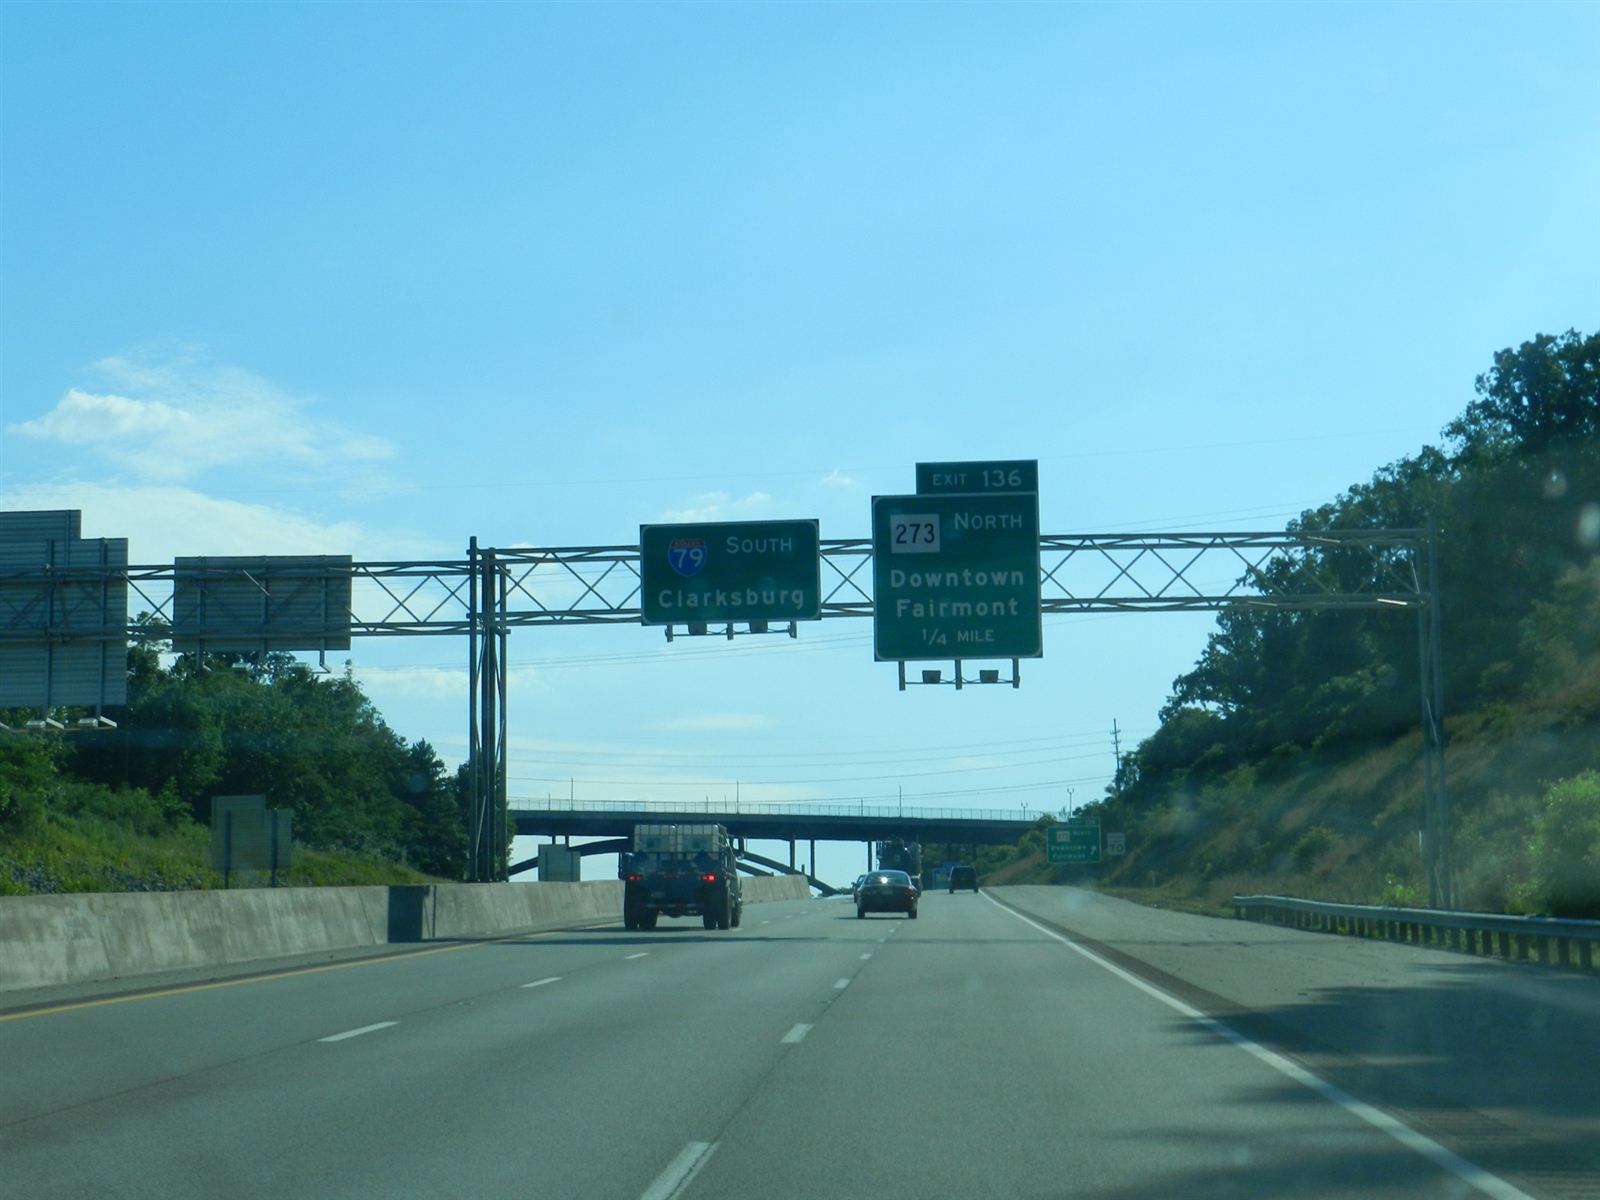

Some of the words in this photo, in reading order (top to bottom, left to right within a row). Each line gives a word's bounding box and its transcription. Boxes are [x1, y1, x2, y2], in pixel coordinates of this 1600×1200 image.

[932, 473, 968, 486] EXIT
[982, 469, 1022, 488] 136
[954, 512, 1023, 530] NORTH
[895, 523, 936, 544] 273
[725, 536, 793, 554] SOUTH
[673, 548, 704, 568] 79
[890, 568, 1024, 588] Downtown
[658, 588, 805, 610] Clarksburg
[896, 597, 1018, 618] Fairmont
[922, 628, 947, 646] 1/4
[957, 629, 995, 642] MILE
